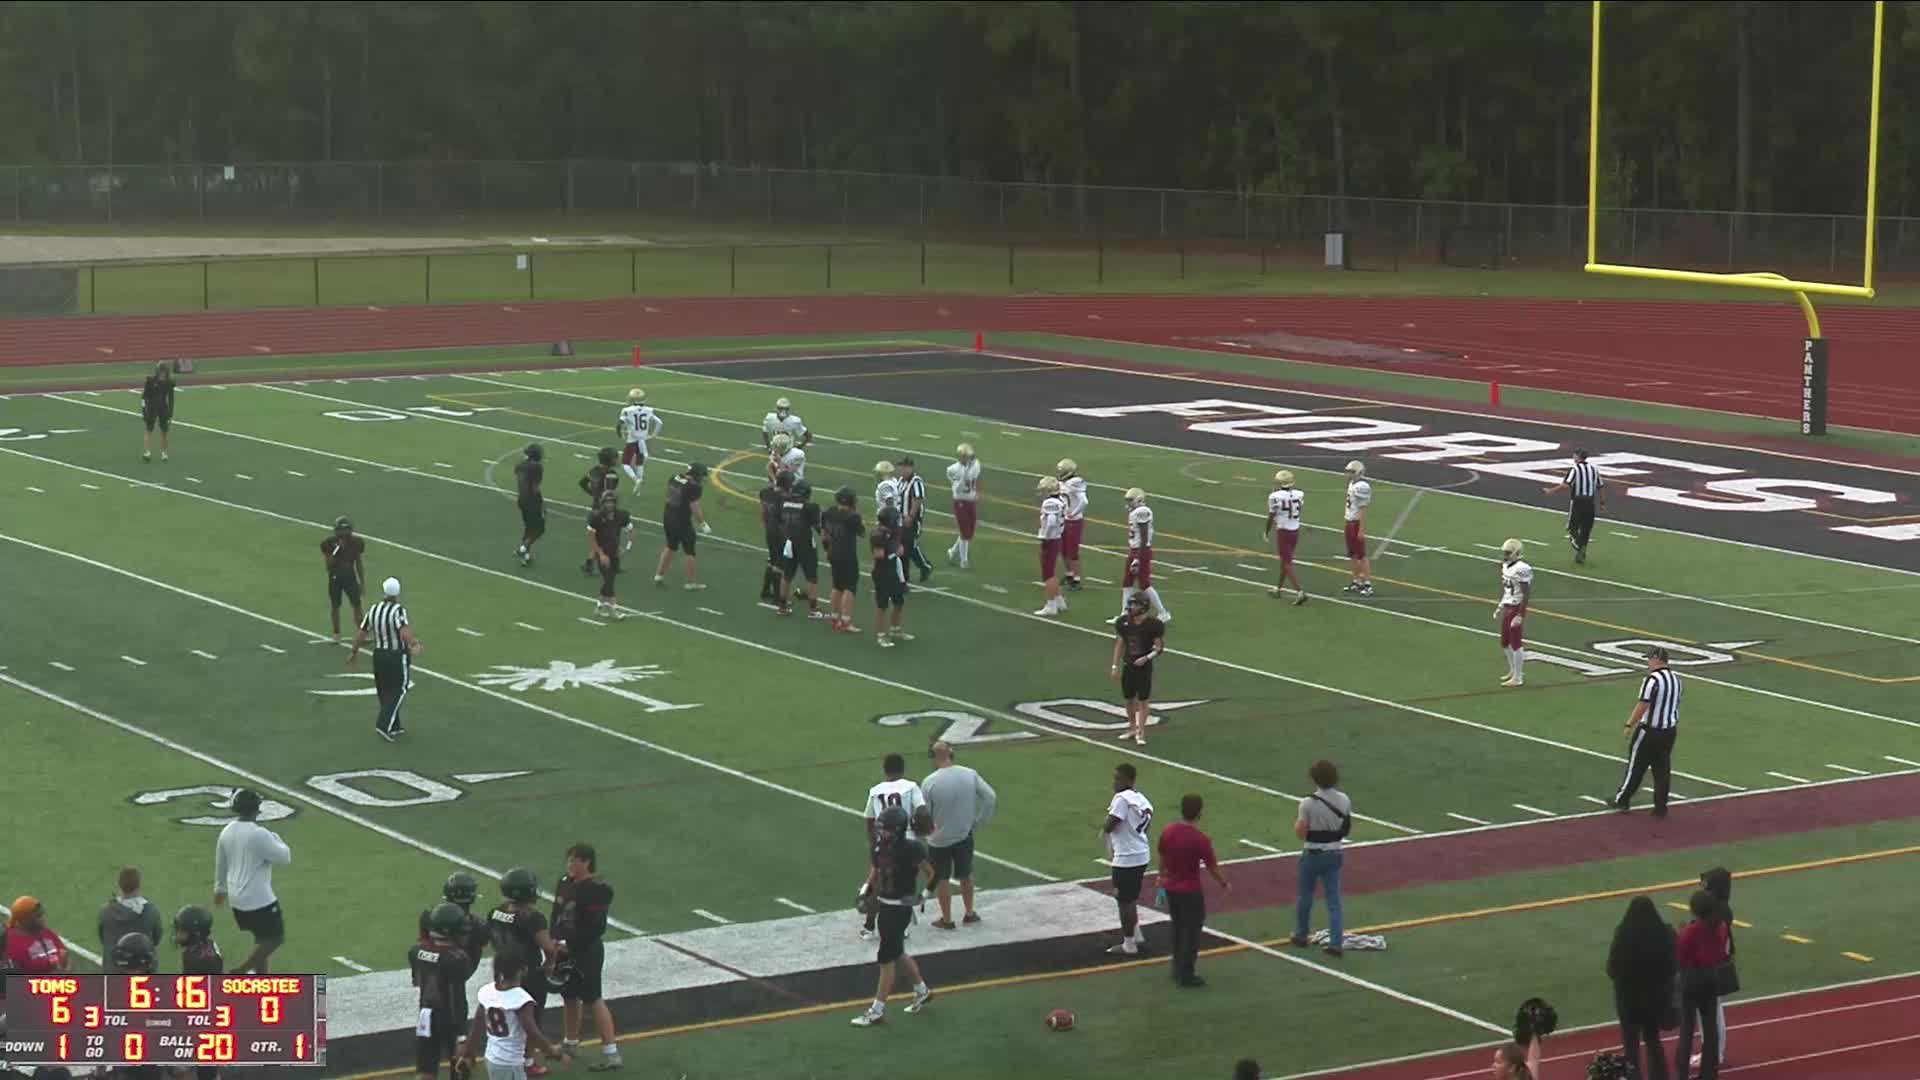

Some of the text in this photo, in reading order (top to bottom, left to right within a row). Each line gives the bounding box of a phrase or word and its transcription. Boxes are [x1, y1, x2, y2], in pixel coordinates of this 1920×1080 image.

[1802, 340, 1814, 434] PANTHERS
[633, 413, 648, 431] 16
[1053, 399, 1920, 542] FORES
[1281, 499, 1301, 519] 43
[878, 698, 1161, 746] 20
[133, 768, 463, 827] 30
